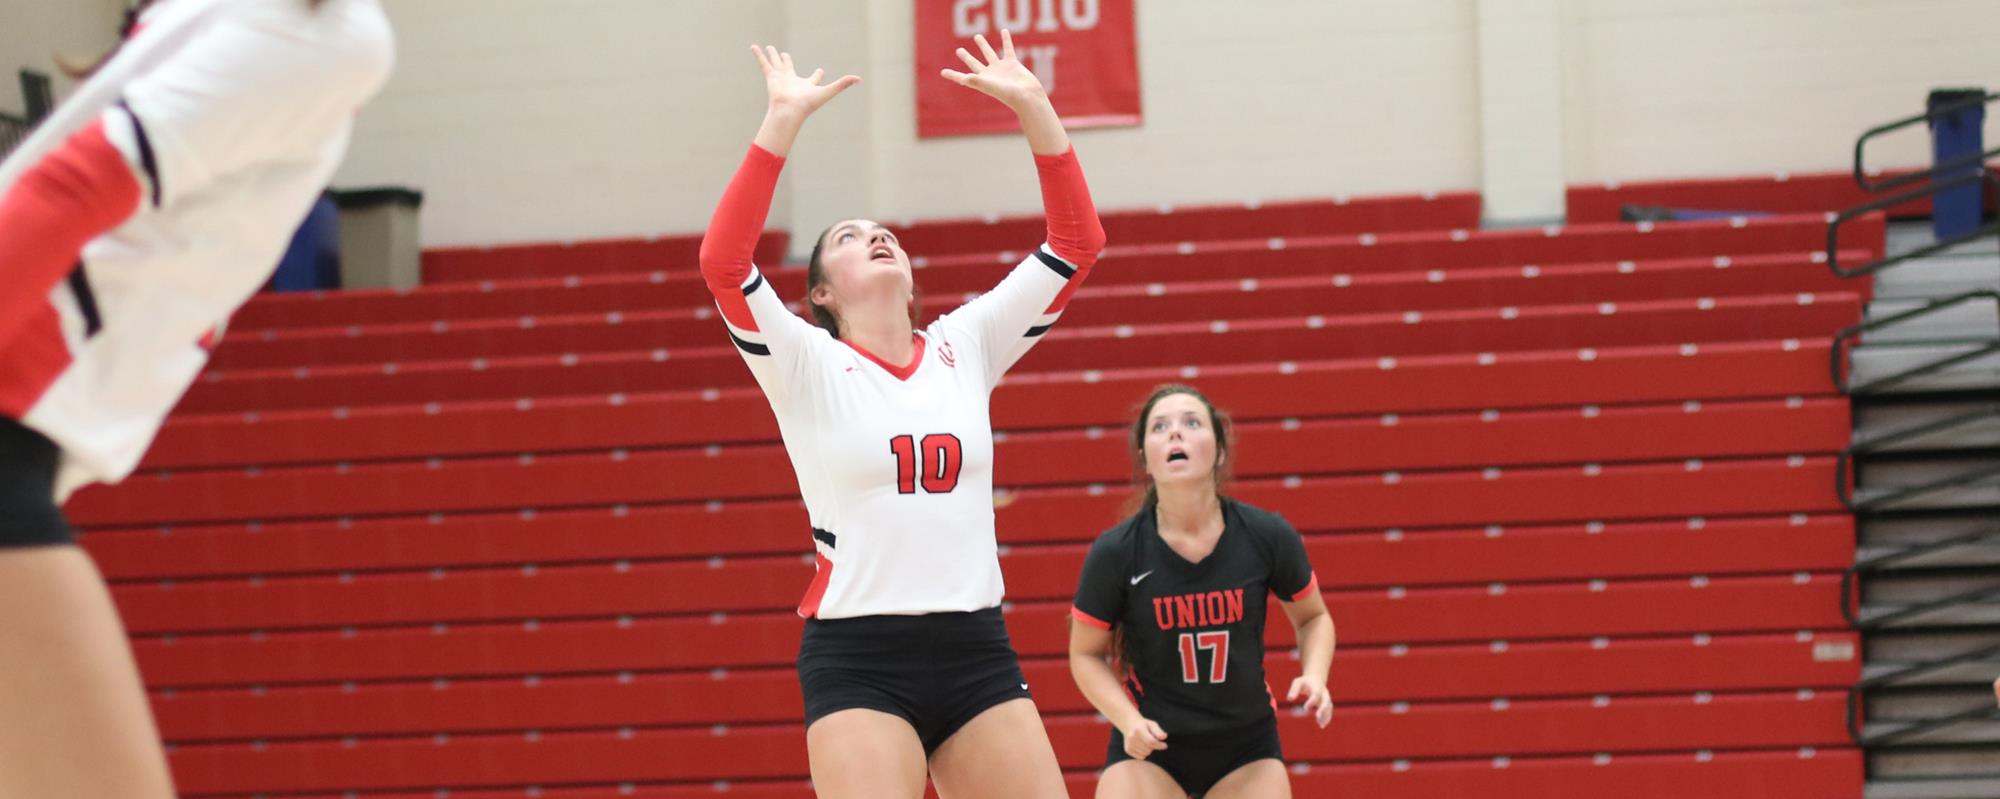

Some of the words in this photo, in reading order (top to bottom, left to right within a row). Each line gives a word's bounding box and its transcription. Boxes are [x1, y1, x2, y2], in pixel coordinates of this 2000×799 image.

[890, 433, 962, 494] 10
[1153, 588, 1244, 631] UNION
[1178, 630, 1230, 684] 17
